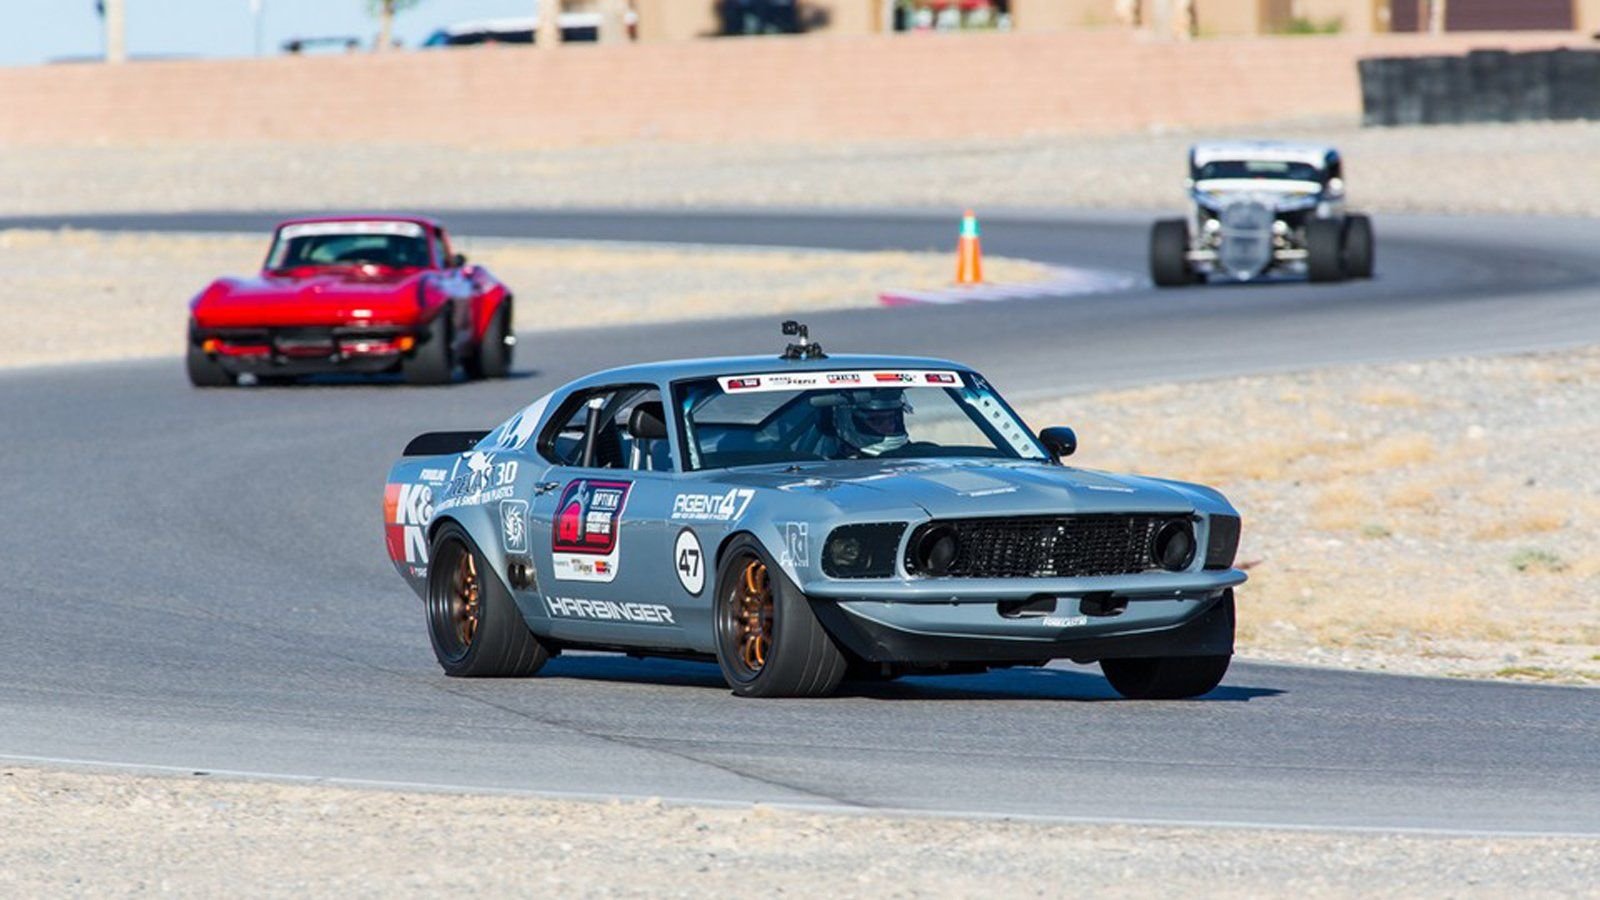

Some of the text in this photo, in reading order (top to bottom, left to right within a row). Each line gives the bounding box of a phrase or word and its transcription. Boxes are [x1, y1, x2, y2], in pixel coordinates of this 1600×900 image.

[496, 461, 518, 485] 3D
[679, 549, 699, 577] 47
[547, 597, 675, 624] HARBINGER
